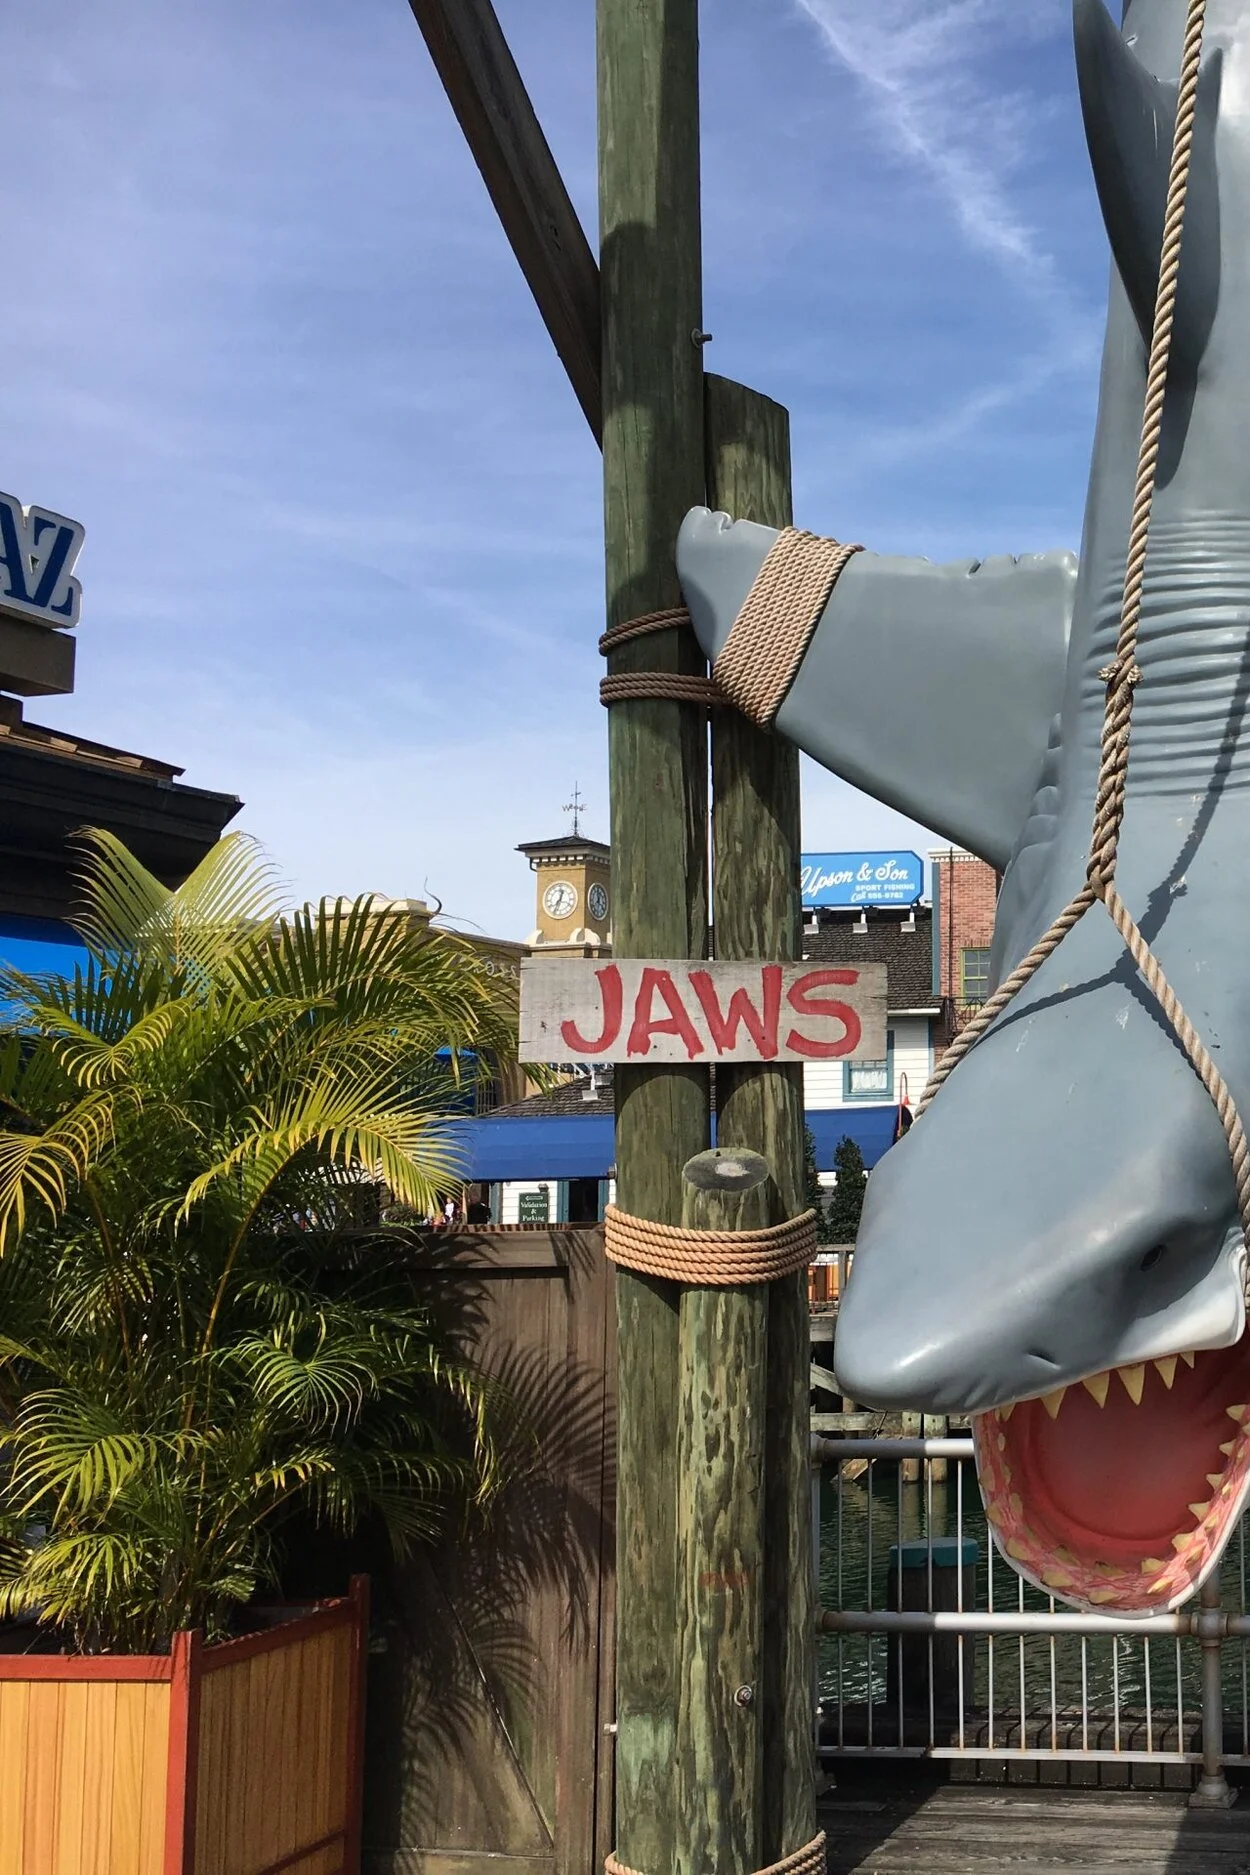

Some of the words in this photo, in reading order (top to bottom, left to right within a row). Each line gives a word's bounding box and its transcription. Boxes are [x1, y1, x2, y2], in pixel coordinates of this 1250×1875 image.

[801, 866, 853, 898] Upson
[856, 862, 873, 882] &
[875, 860, 908, 881] Son
[855, 884, 881, 892] SPORT
[883, 883, 915, 891] FISHING
[560, 963, 861, 1060] JAWS
